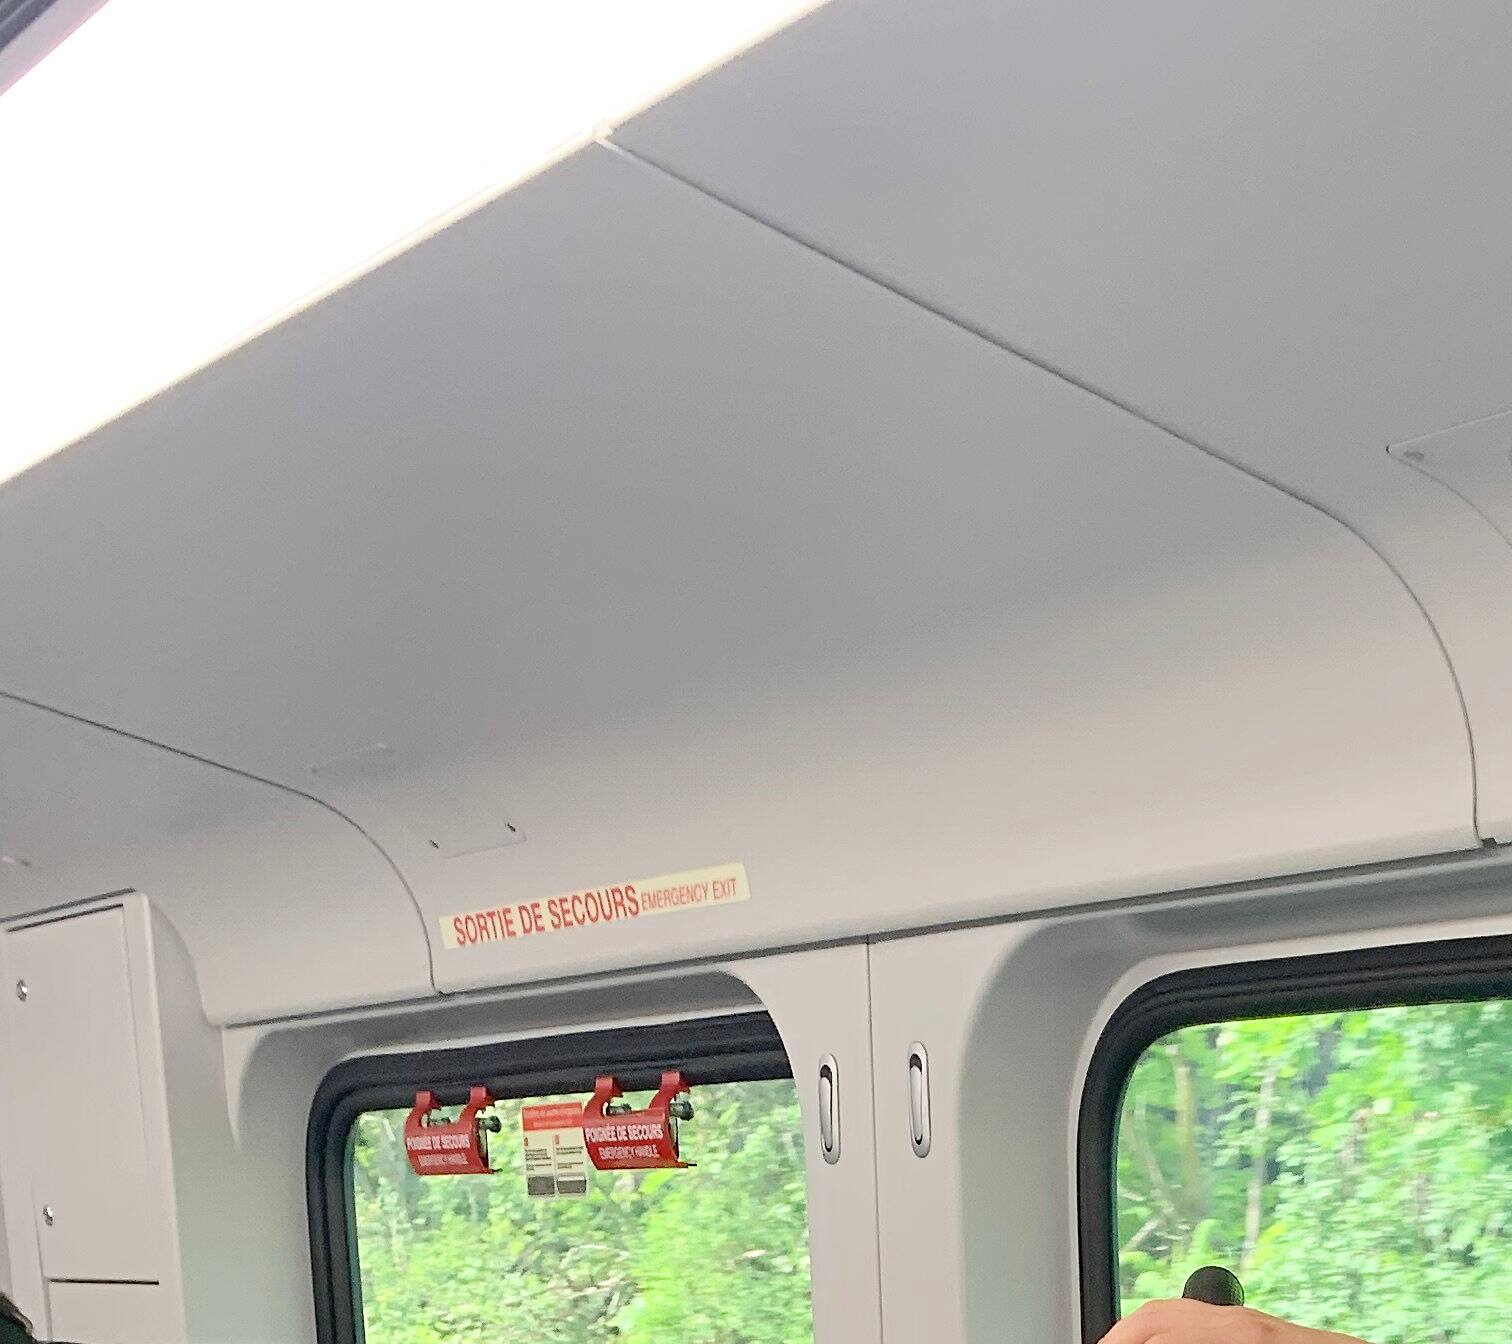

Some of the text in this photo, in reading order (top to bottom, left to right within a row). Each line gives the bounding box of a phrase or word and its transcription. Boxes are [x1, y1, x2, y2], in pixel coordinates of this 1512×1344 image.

[453, 877, 737, 947] SORTIE DE SECOURS EMERGENCY EXIT
